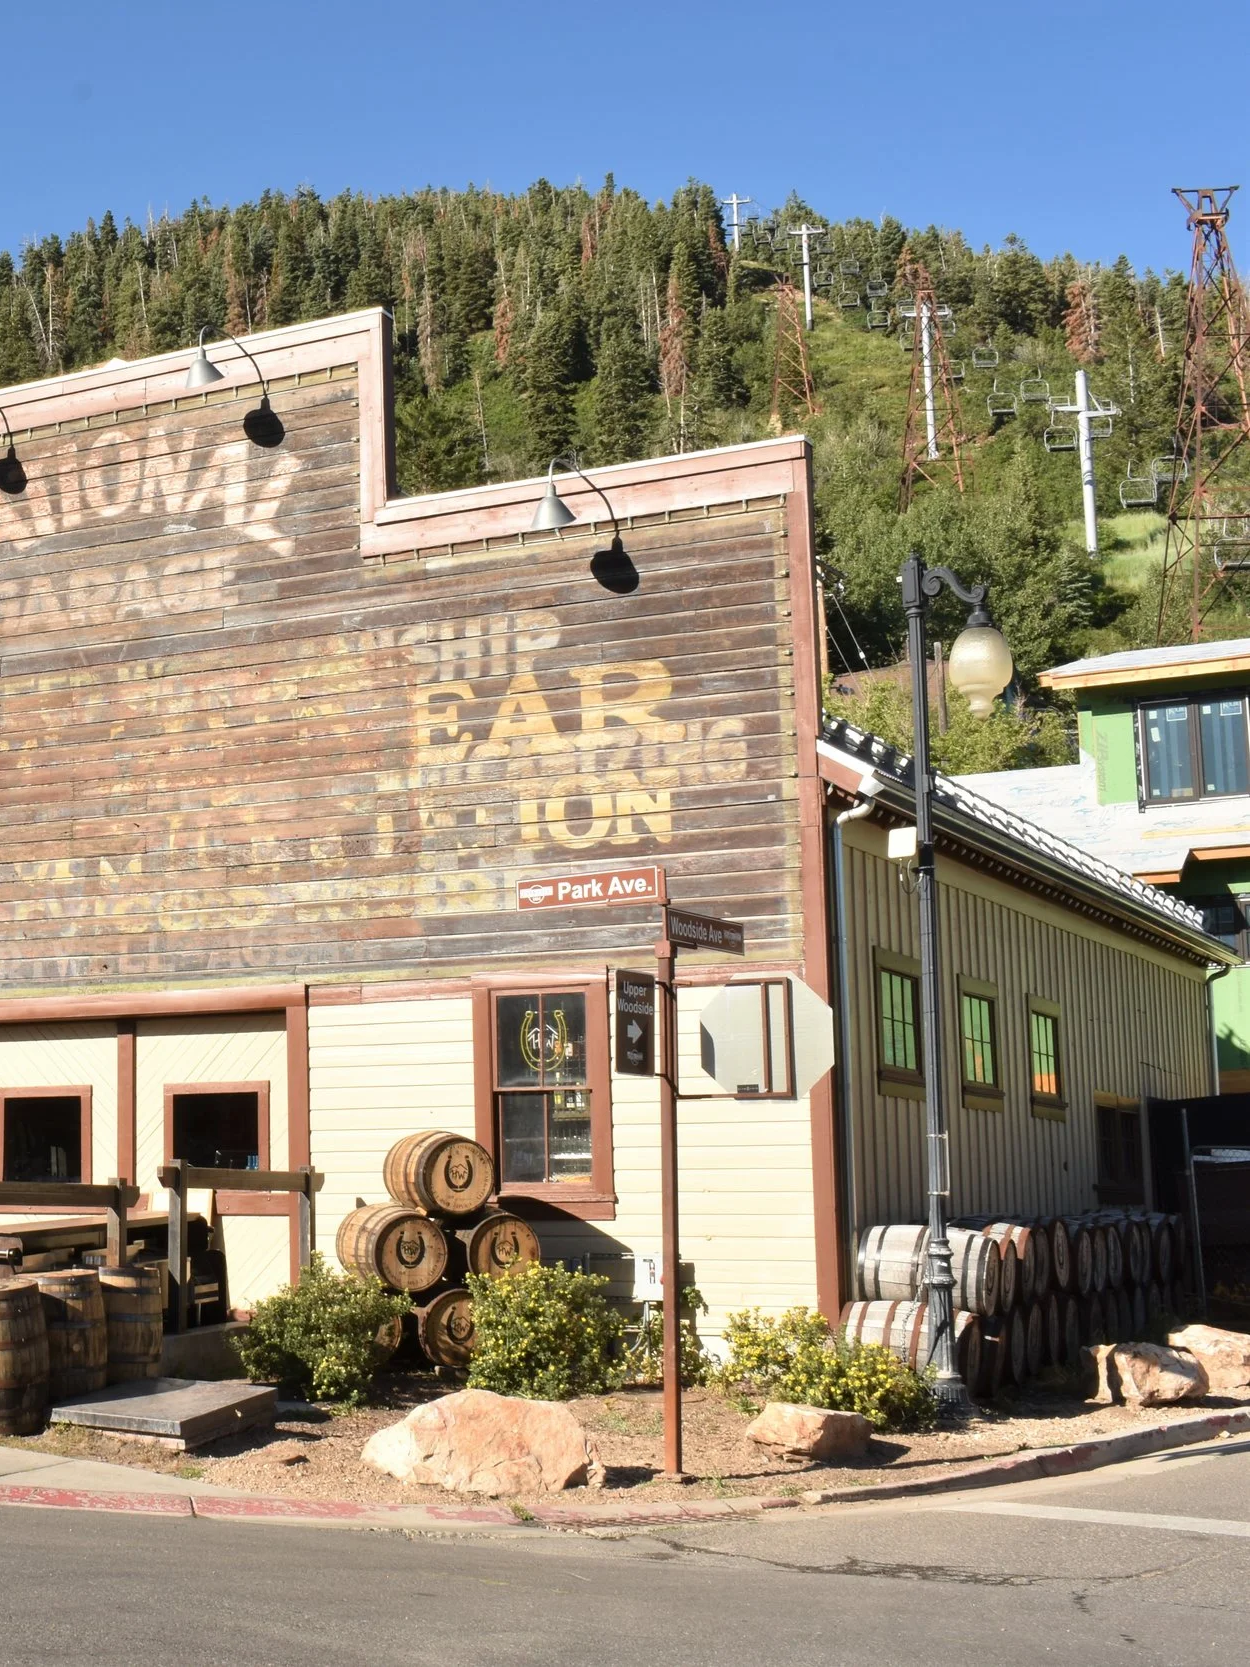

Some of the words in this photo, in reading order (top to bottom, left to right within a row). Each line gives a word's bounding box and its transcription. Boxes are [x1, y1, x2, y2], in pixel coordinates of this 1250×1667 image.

[557, 878, 603, 901] Park
[607, 876, 653, 896] Ave.
[670, 915, 707, 941] Woodside
[709, 924, 723, 944] Ave
[623, 980, 647, 998] Upper
[617, 998, 654, 1015] Woodside
